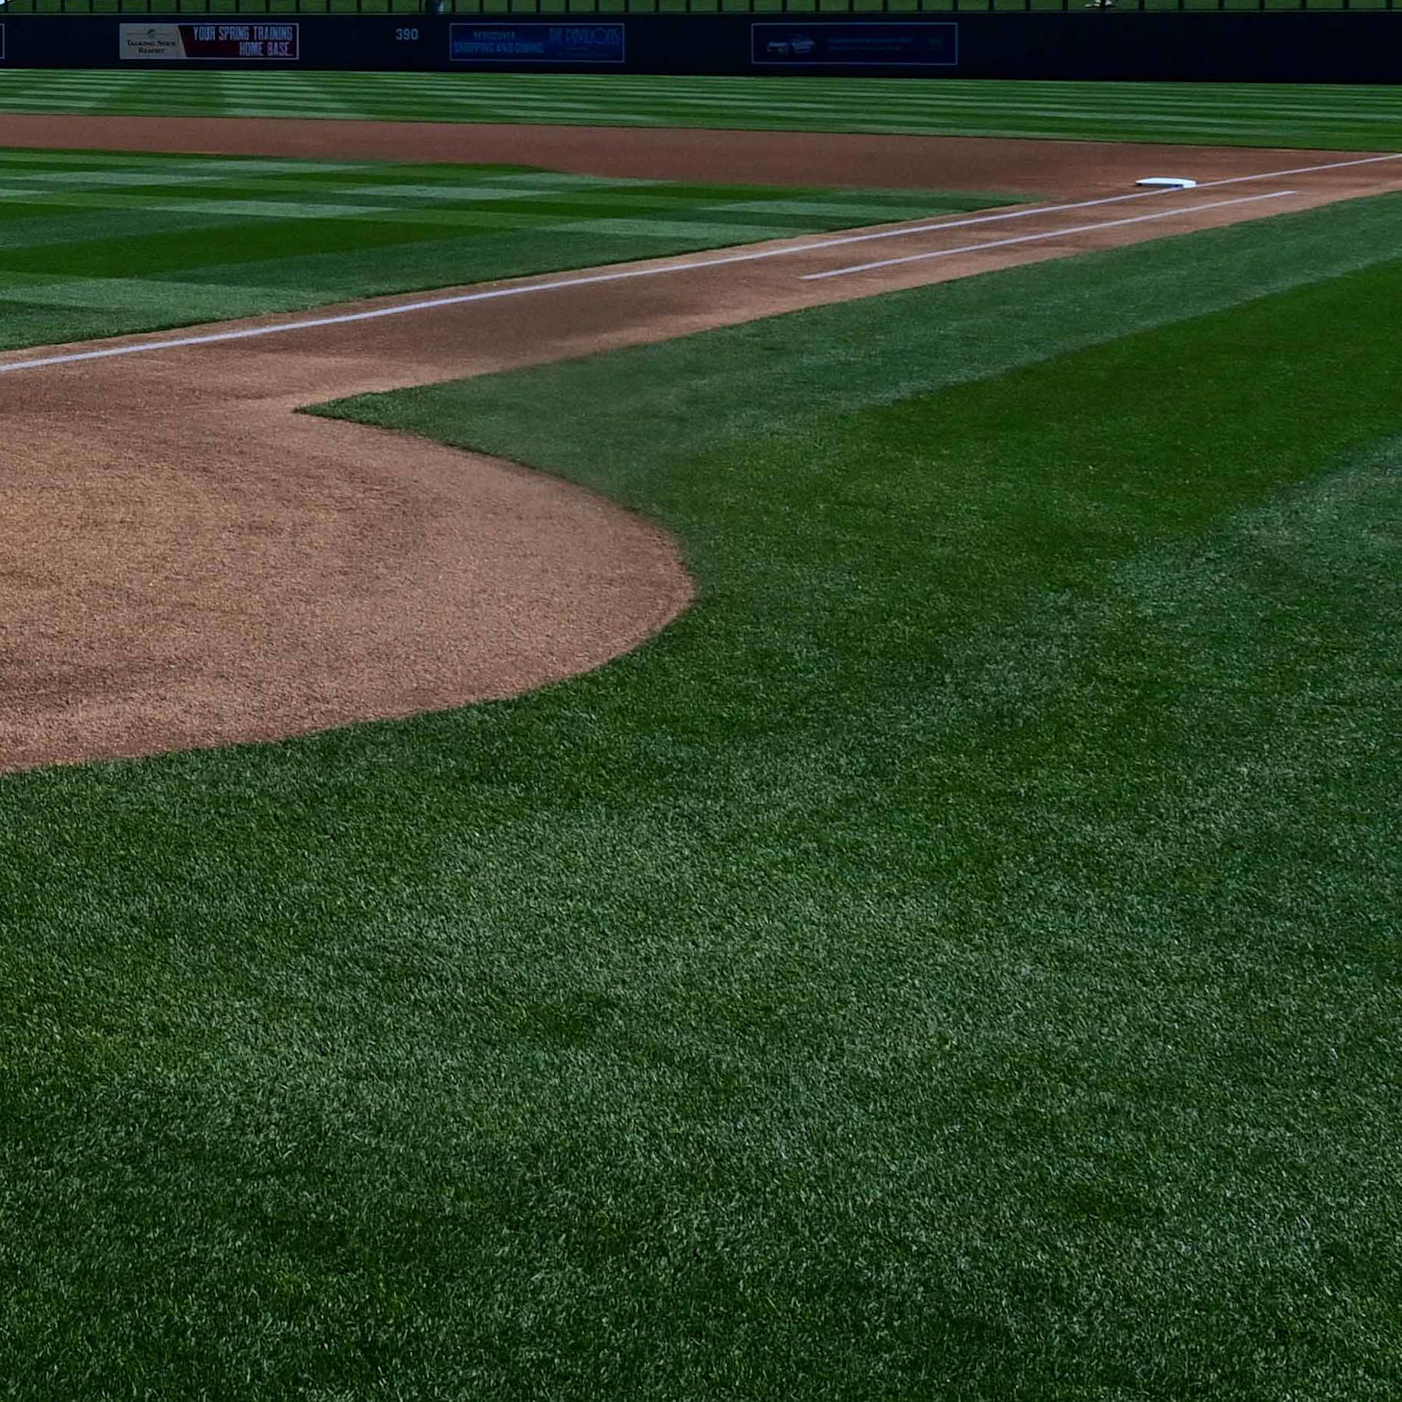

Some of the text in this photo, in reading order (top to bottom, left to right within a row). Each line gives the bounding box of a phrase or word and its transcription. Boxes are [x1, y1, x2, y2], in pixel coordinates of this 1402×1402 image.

[193, 26, 292, 41] YOUR SPRING TRAINING
[396, 28, 418, 40] 390
[239, 41, 263, 56] HOME
